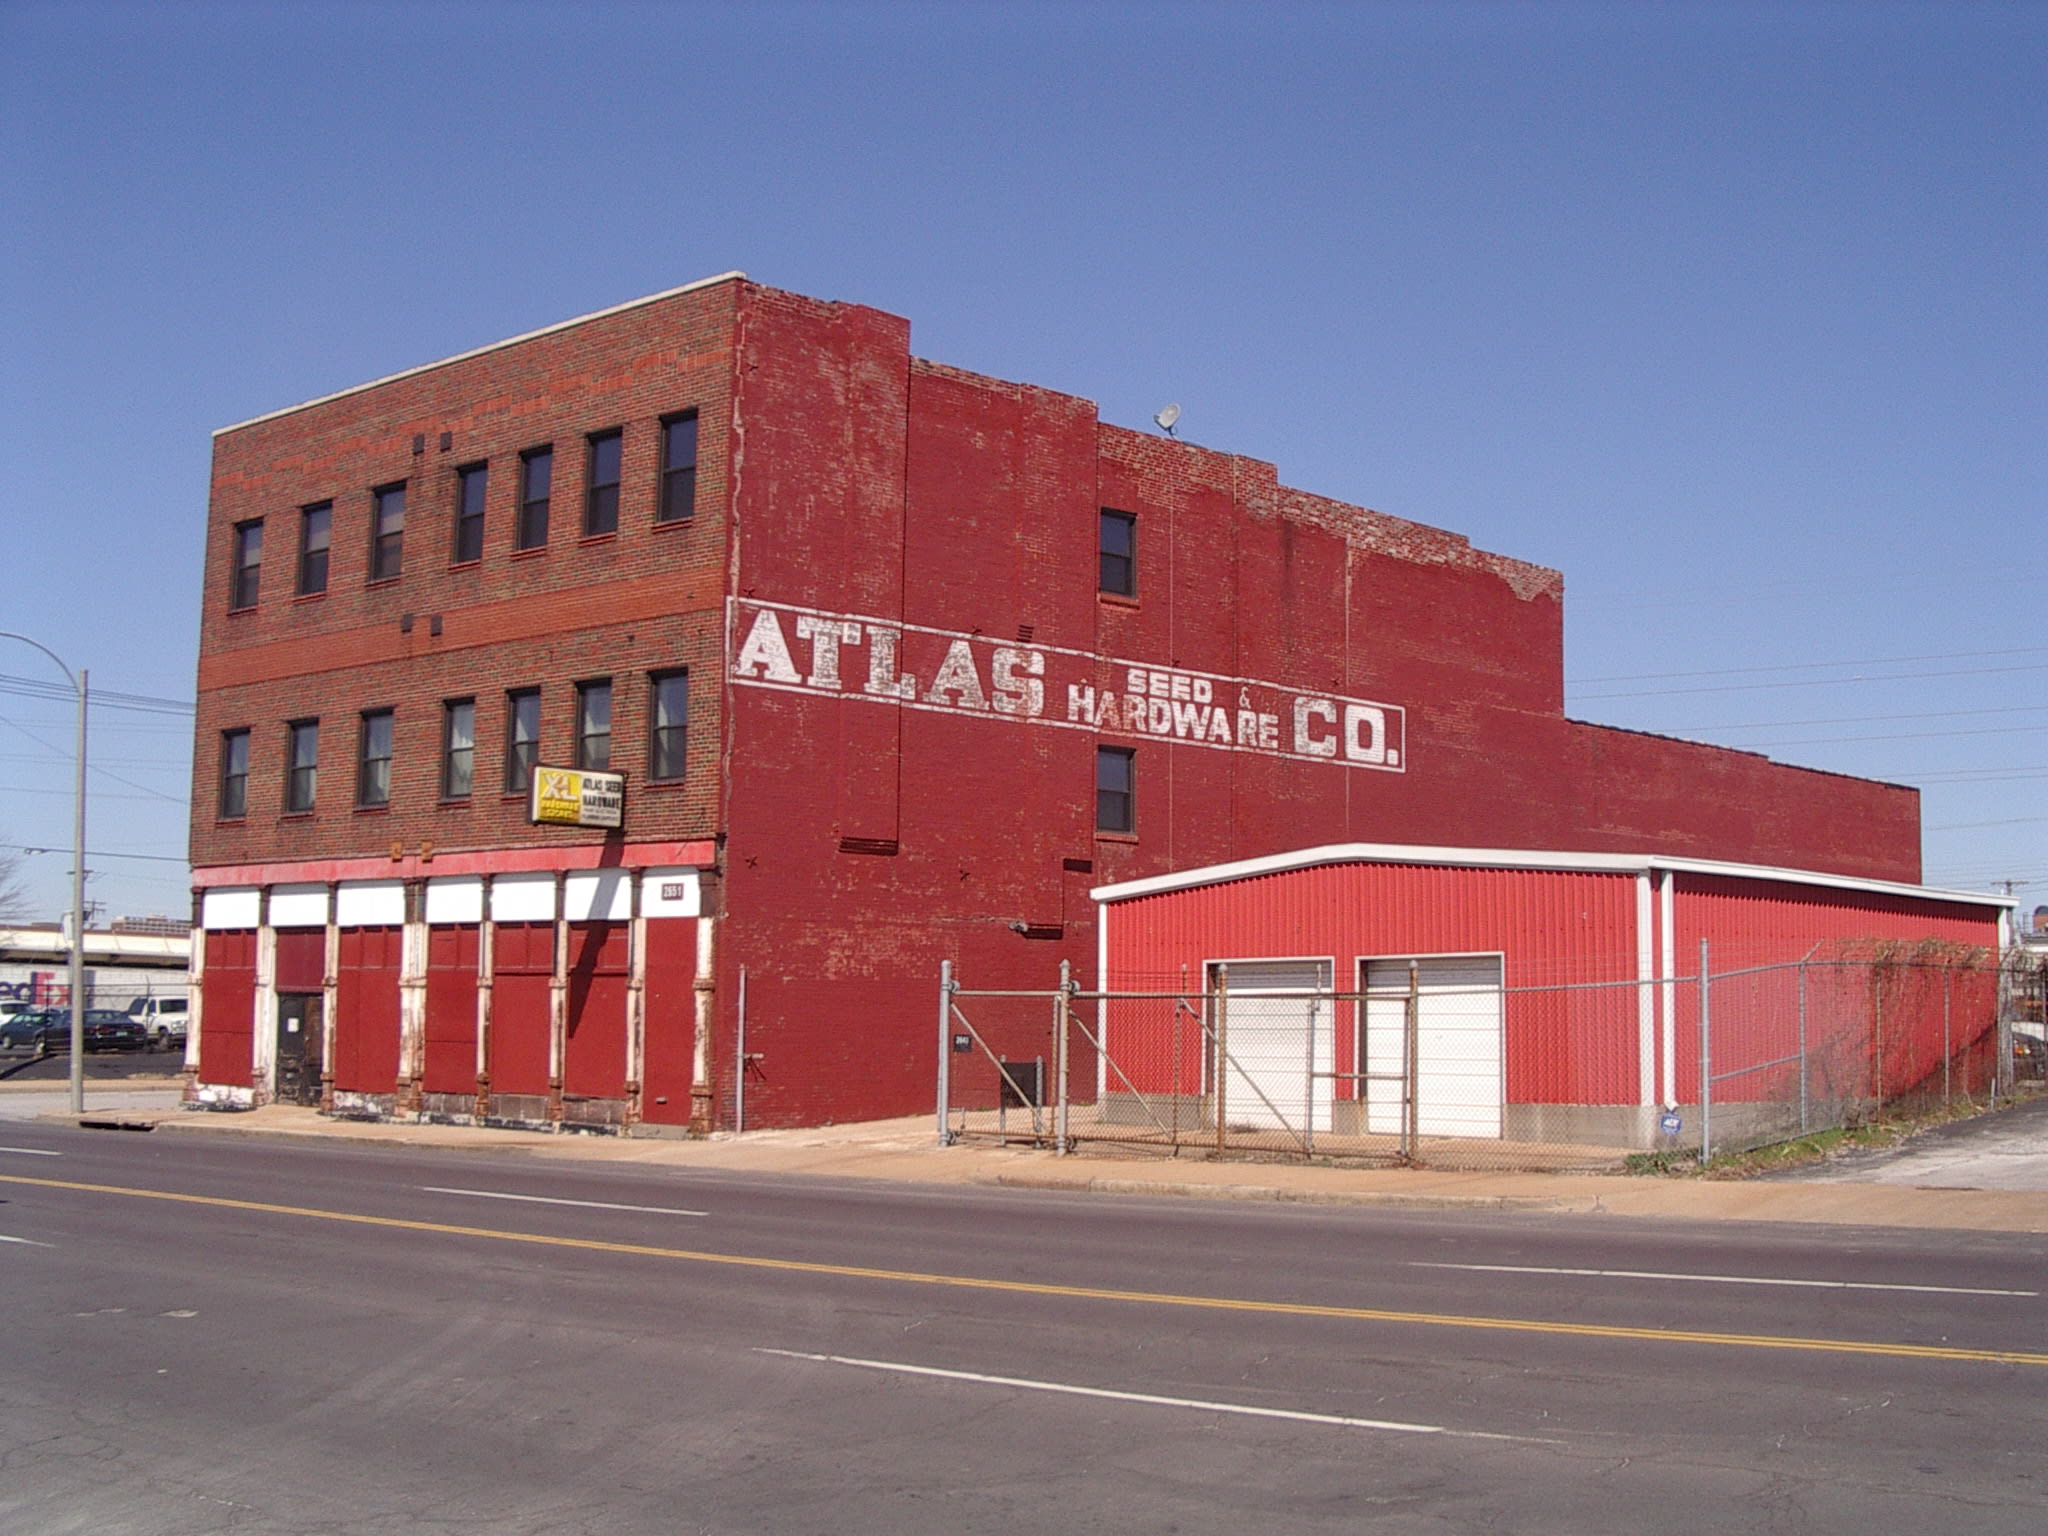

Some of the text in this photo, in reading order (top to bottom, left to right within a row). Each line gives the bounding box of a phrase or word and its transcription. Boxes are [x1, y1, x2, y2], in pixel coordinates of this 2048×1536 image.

[734, 610, 1045, 717] ATLAS
[1127, 668, 1252, 709] SEED &
[1067, 684, 1279, 749] HARDWARE
[1293, 696, 1399, 766] CO.
